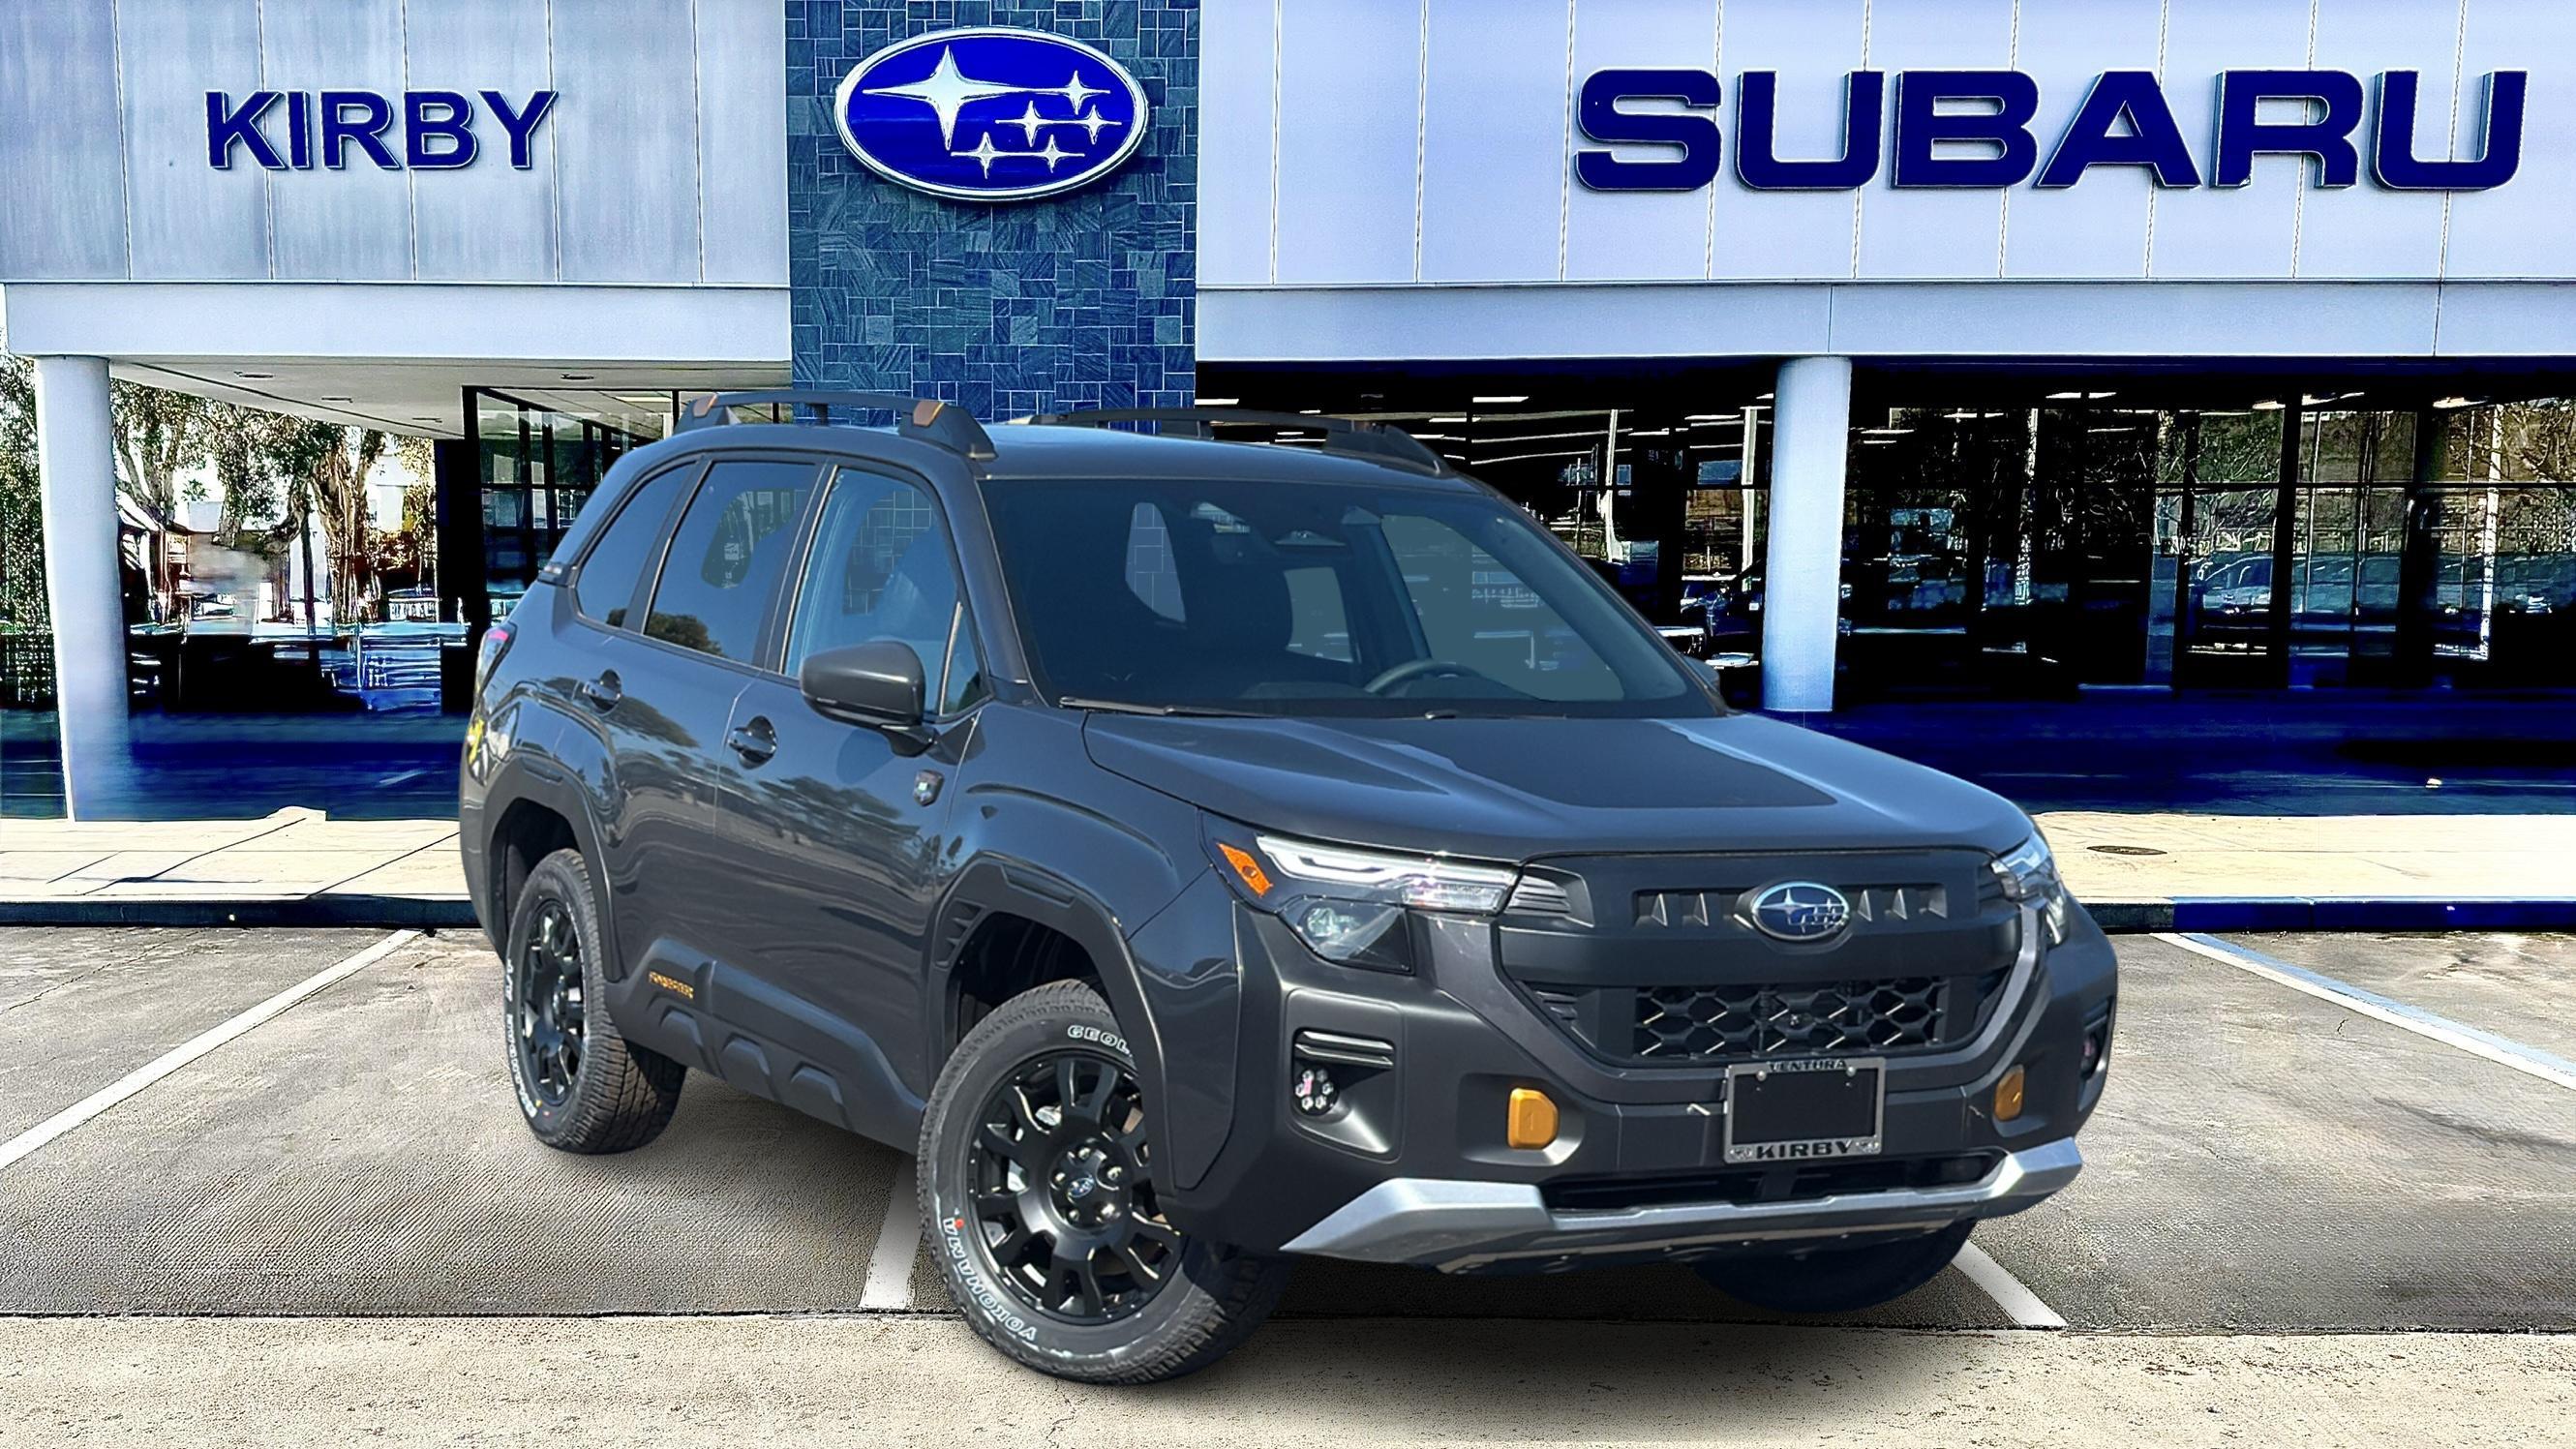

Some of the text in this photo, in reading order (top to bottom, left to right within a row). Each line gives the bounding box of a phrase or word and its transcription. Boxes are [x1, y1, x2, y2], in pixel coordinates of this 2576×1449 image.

[204, 89, 559, 170] KIRBY
[1574, 69, 2529, 192] SUBARU
[1067, 1024, 1133, 1058] GEOL
[1756, 1140, 1854, 1160] KIRBY
[943, 1217, 1038, 1341] YOKOHAMA
